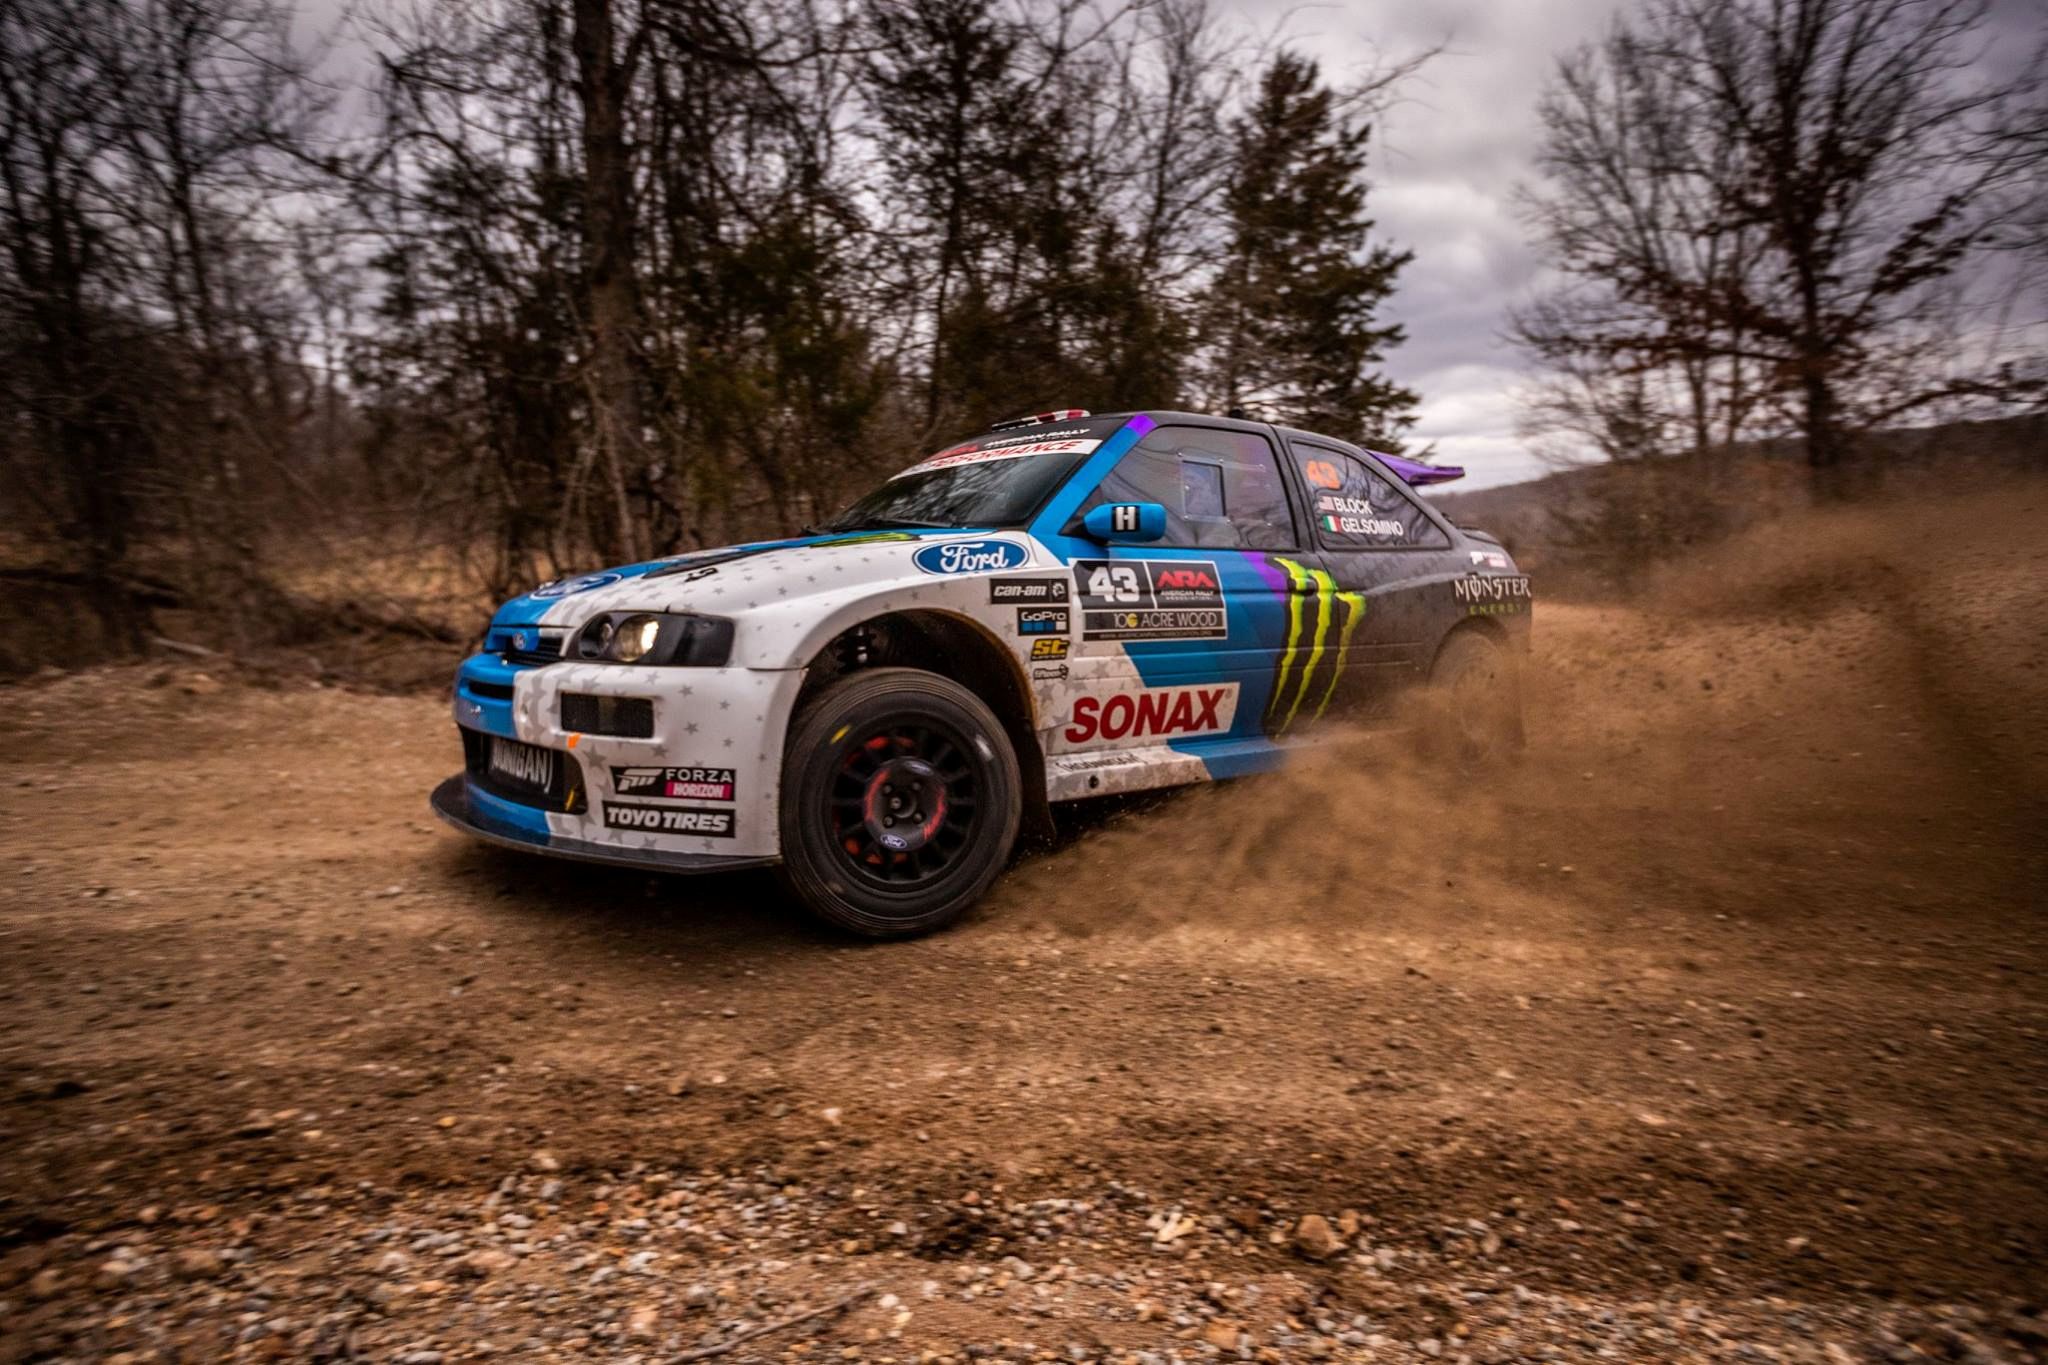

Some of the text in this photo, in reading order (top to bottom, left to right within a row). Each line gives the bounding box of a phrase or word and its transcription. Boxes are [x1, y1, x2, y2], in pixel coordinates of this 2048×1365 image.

[1333, 497, 1373, 515] BLOCK
[1115, 506, 1136, 531] H
[1341, 517, 1404, 536] GELSOMINO
[940, 543, 1009, 572] Ford
[994, 585, 1047, 597] can-am
[1088, 566, 1140, 602] 43
[1021, 612, 1067, 621] GoPro
[1141, 613, 1175, 627] ACRE
[1177, 612, 1217, 627] WOOD
[1065, 689, 1225, 743] SONAX
[665, 768, 733, 782] FORZA
[673, 782, 724, 798] HORIZON
[607, 807, 730, 832] TOYO TIRES
